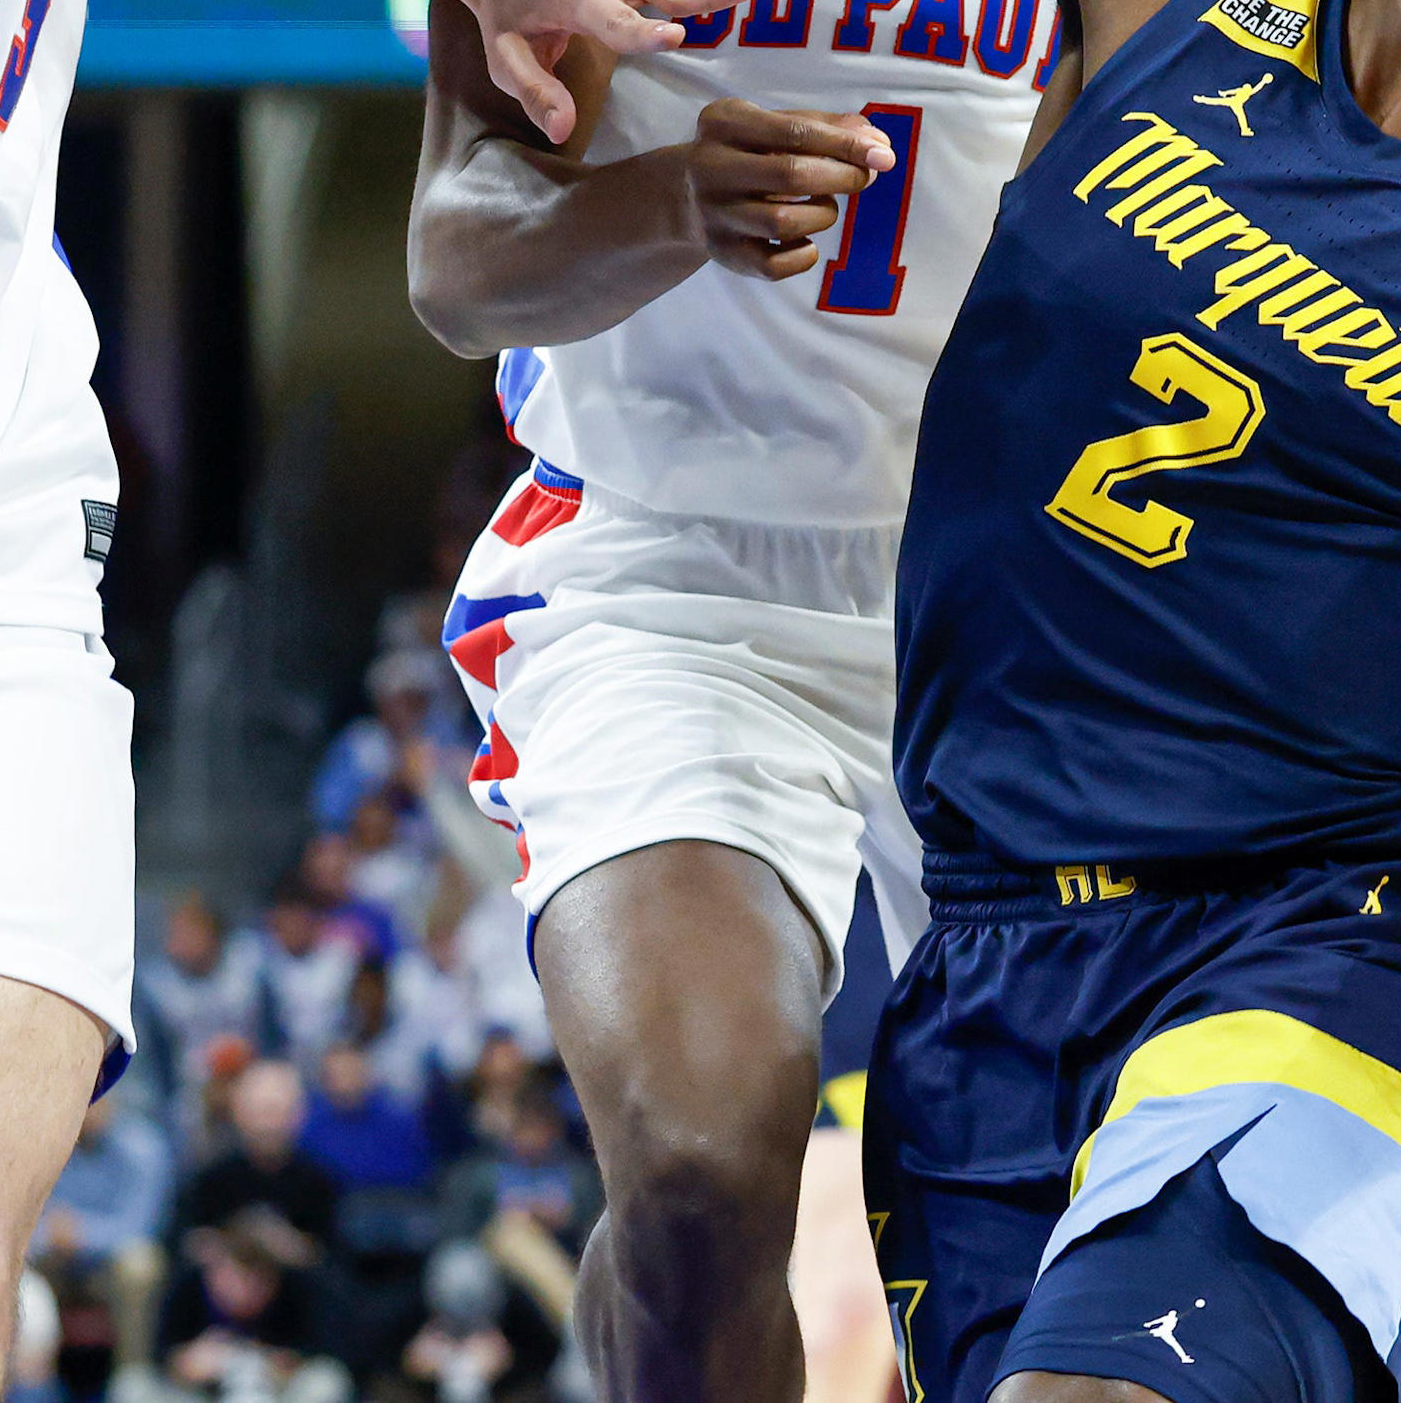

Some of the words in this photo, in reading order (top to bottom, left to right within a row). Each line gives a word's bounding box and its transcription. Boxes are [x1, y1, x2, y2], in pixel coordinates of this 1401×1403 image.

[1265, 5, 1308, 31] THE
[816, 102, 923, 317] 1
[1044, 332, 1267, 569] 2
